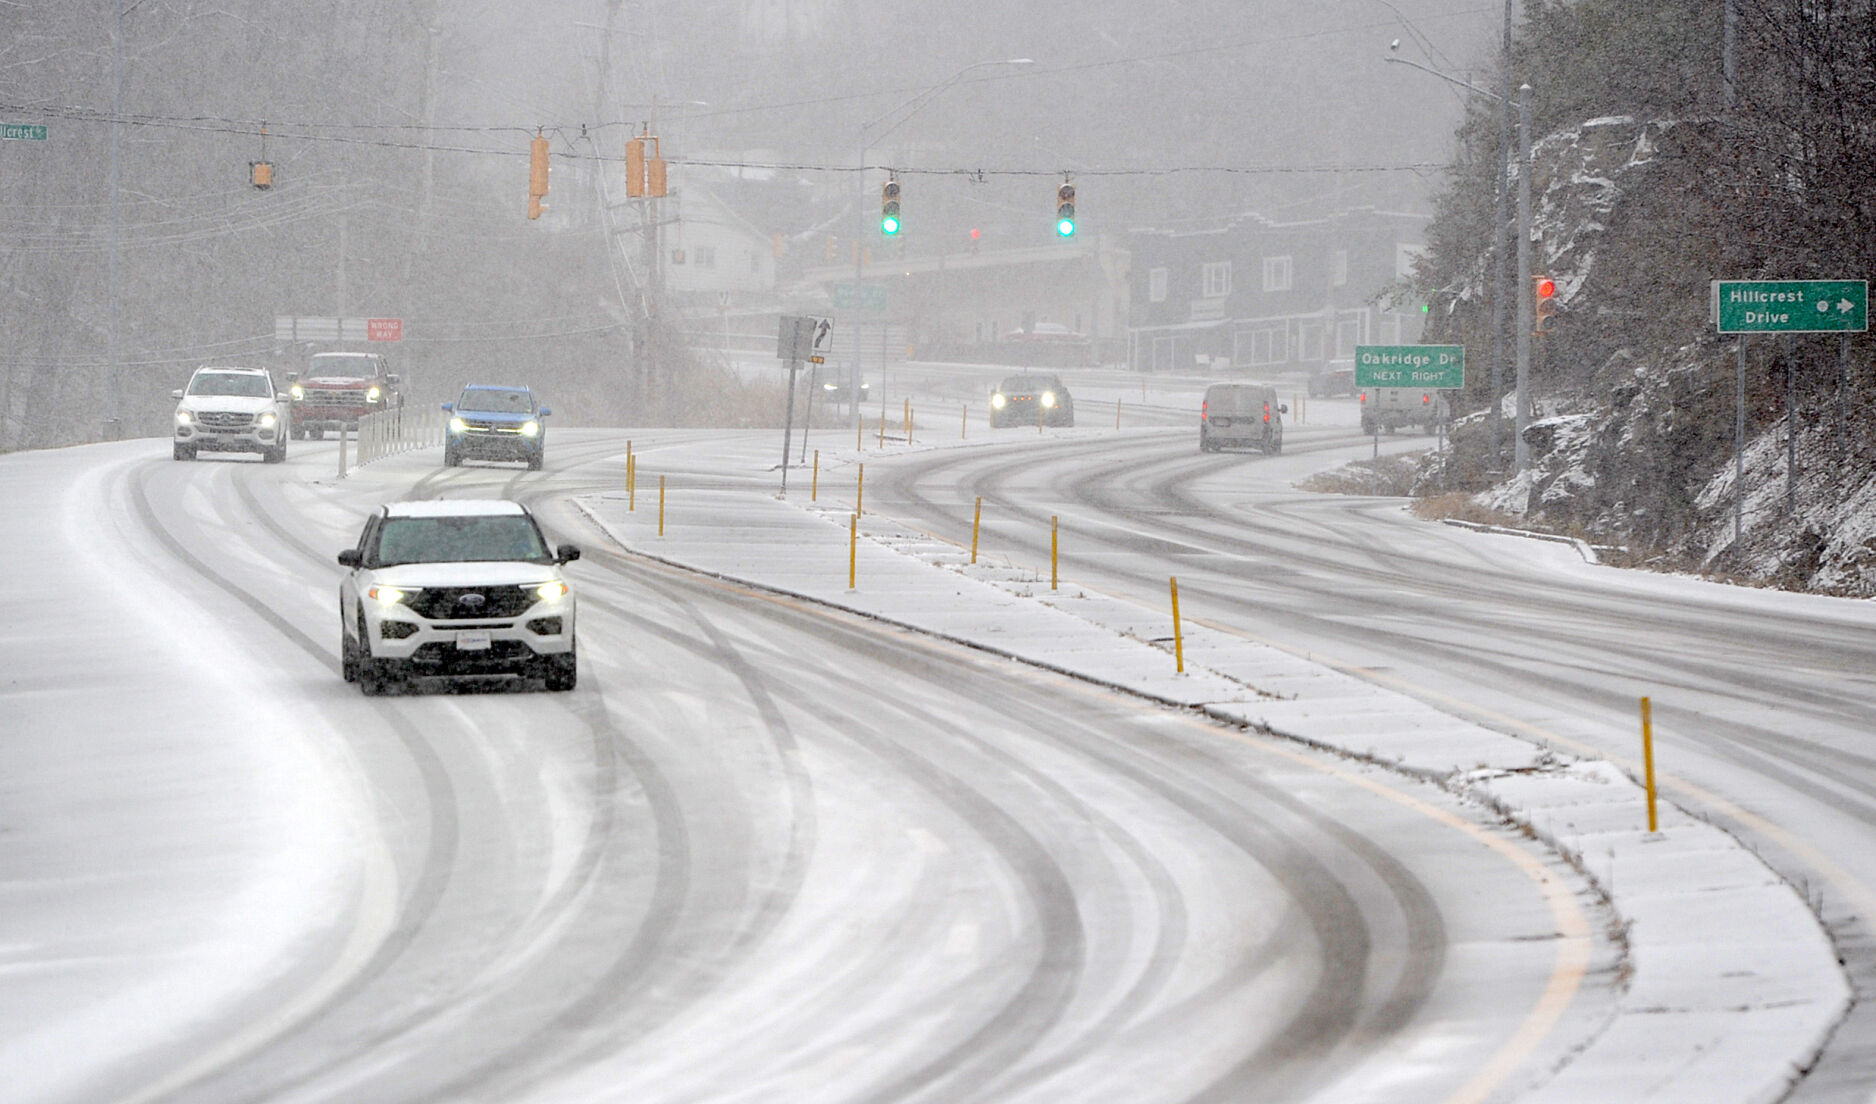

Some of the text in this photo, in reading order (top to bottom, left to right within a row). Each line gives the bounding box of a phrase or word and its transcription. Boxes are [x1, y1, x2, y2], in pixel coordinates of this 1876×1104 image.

[1730, 290, 1804, 303] Hillcrest
[1745, 311, 1789, 323] Drive
[1362, 353, 1457, 368] Oakridge Dr
[1373, 371, 1445, 381] NEXT RIGHT
